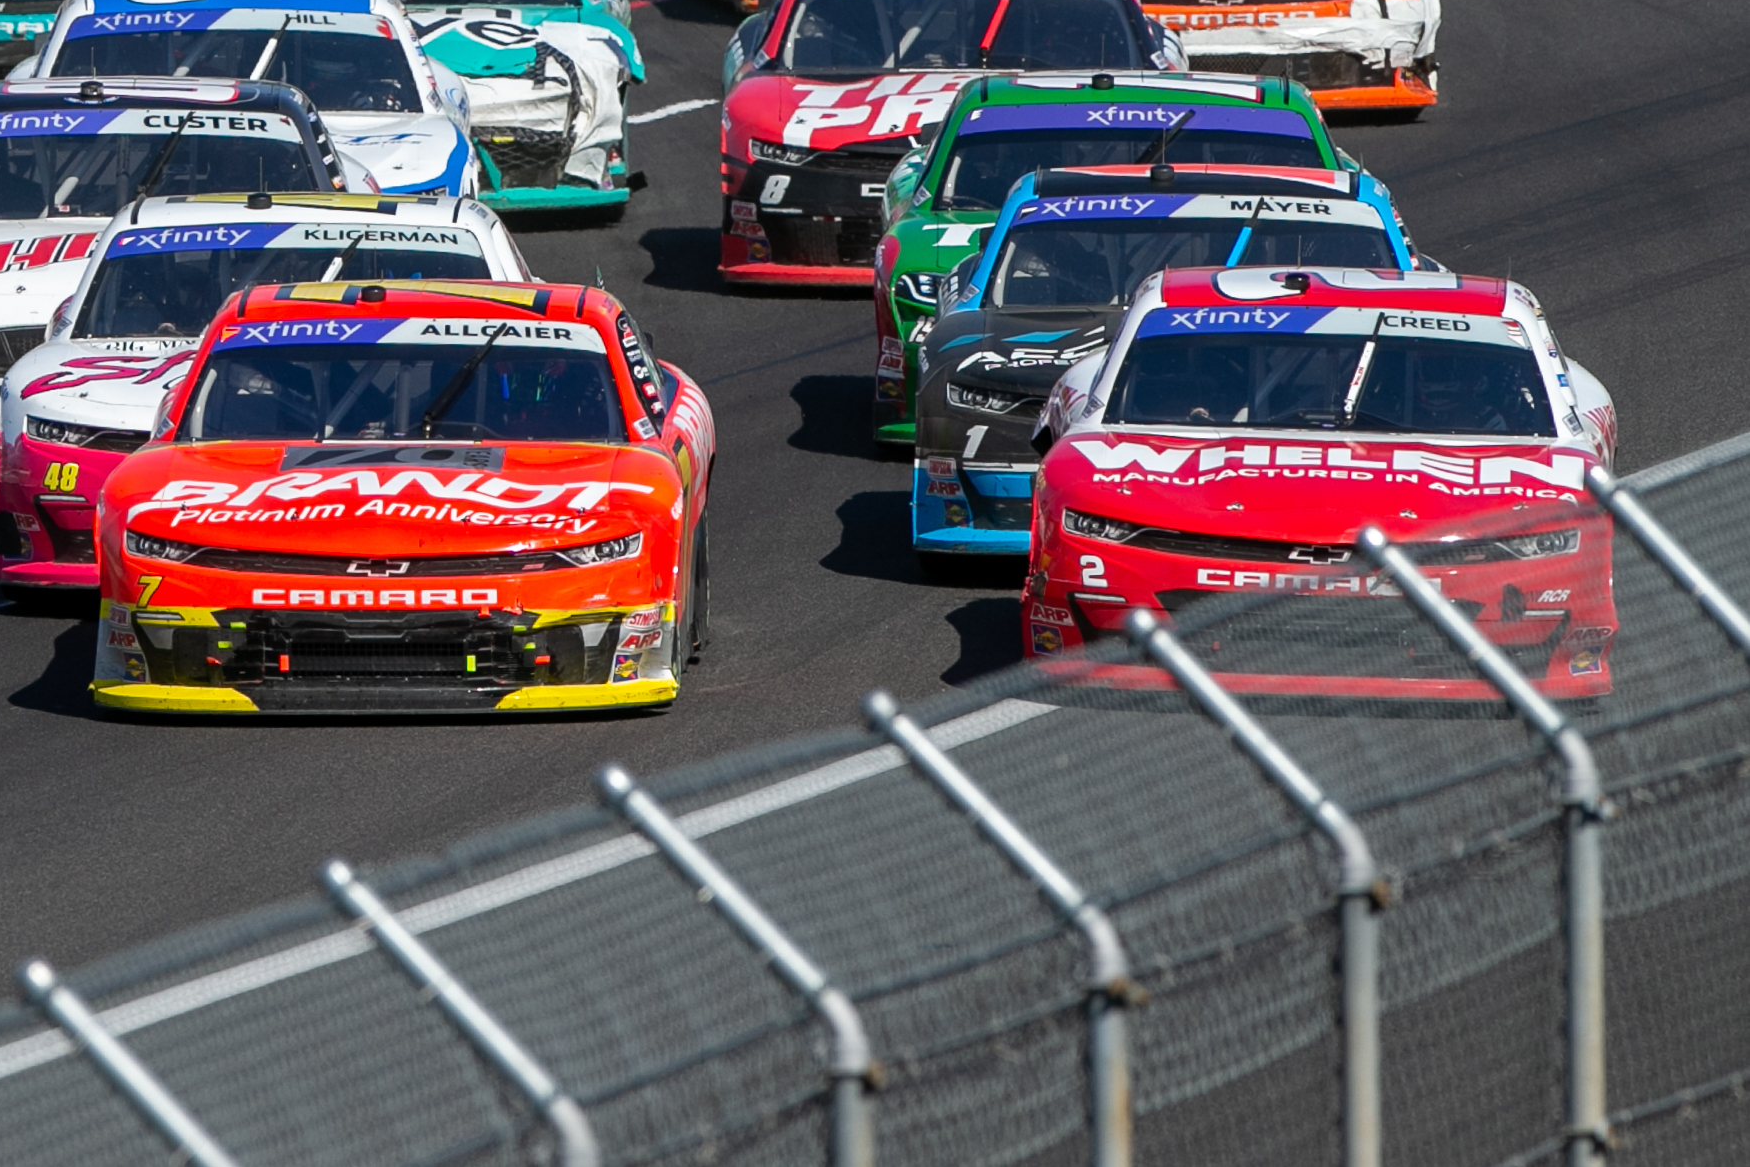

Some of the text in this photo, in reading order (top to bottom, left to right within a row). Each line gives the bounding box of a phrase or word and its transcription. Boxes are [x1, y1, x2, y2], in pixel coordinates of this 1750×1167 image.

[92, 10, 195, 30] xfinity
[286, 13, 337, 26] HILL
[143, 114, 268, 132] CUSTER
[1086, 106, 1190, 126] xfinity
[759, 174, 791, 205] 8
[1043, 197, 1156, 218] xfinity
[1229, 200, 1333, 216] MAYER
[136, 226, 252, 250] xfinity
[303, 229, 459, 245] KLIGERMAN
[1170, 308, 1291, 330] xfinity
[1383, 314, 1471, 332] CREED
[243, 319, 364, 345] xfinity
[420, 320, 572, 341] ALLGAIER
[962, 424, 989, 459] 1
[1070, 440, 1586, 492] WHELEN
[43, 461, 80, 493] 48
[1092, 468, 1580, 505] MANUFACTURED IN AMERICA
[127, 471, 655, 524] BRANDT
[928, 481, 961, 496] ARP
[170, 498, 598, 535] Platinum Anniversary
[1079, 554, 1109, 588] 2
[136, 574, 164, 609] 7
[252, 588, 498, 607] CAMARO
[1538, 589, 1571, 603] RCR
[1031, 604, 1070, 621] ARP
[109, 630, 136, 647] ARP
[621, 631, 662, 649] ARP
